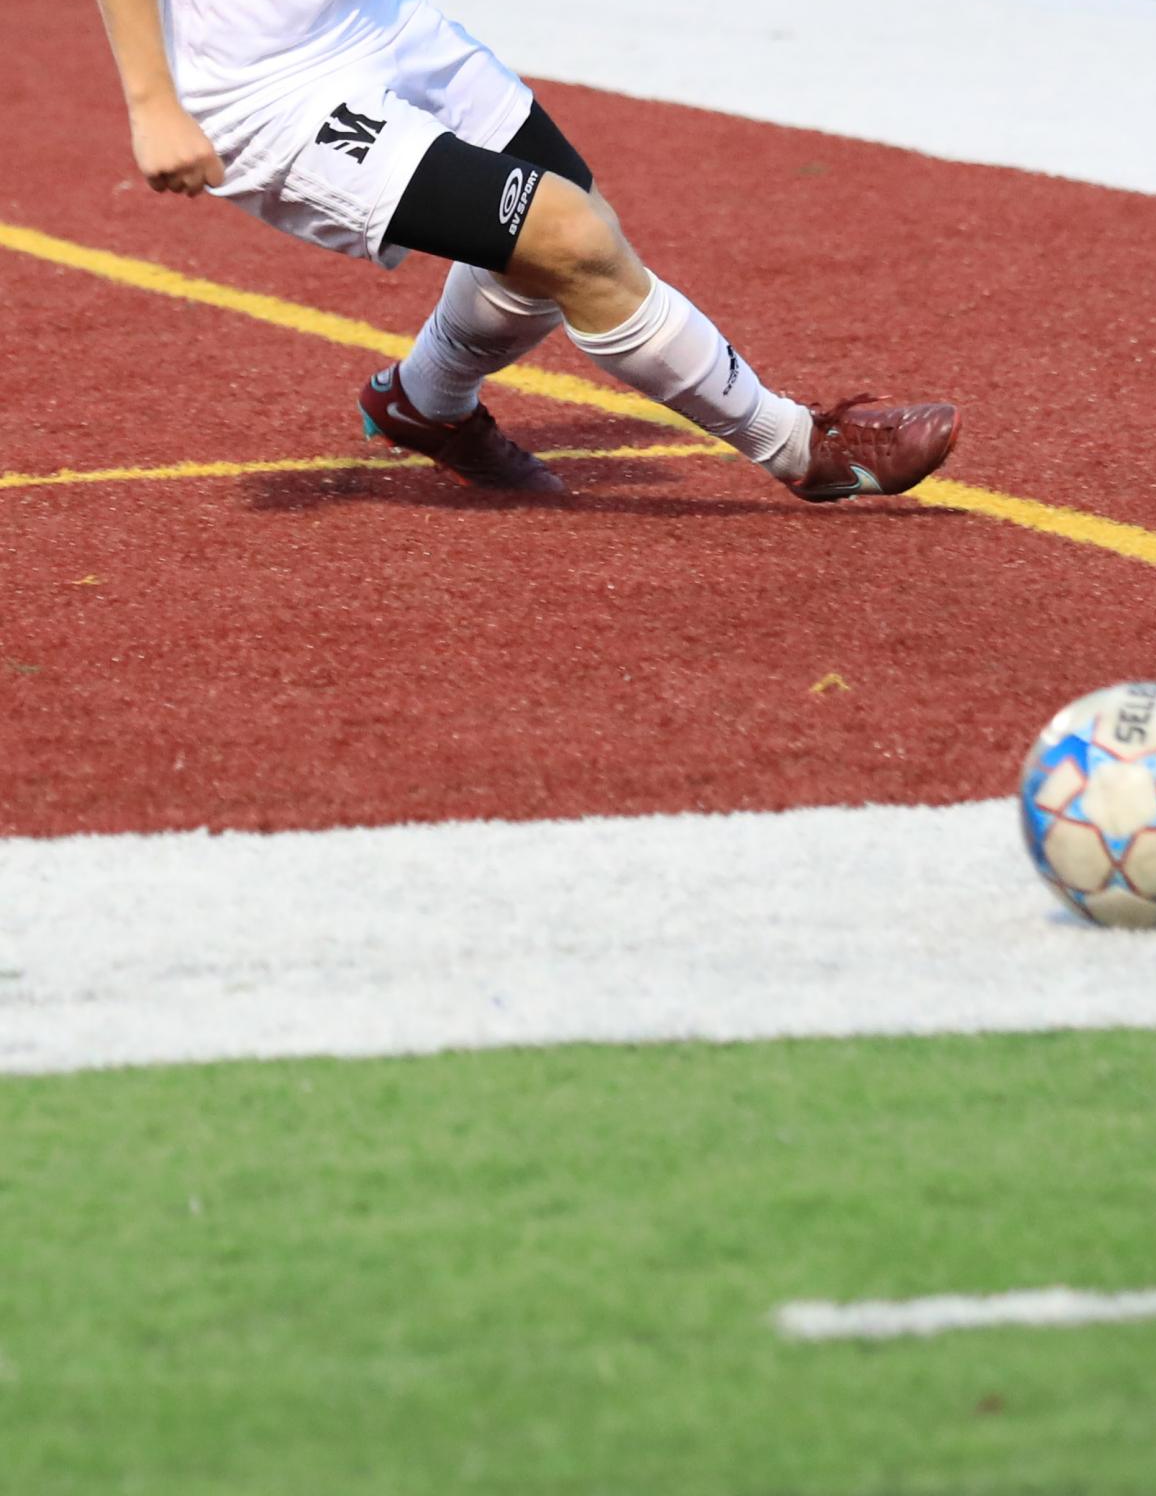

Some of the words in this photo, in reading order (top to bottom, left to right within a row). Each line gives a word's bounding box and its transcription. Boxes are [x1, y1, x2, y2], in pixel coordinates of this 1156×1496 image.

[314, 101, 388, 165] M
[508, 212, 521, 236] BV
[517, 170, 540, 215] SPORT
